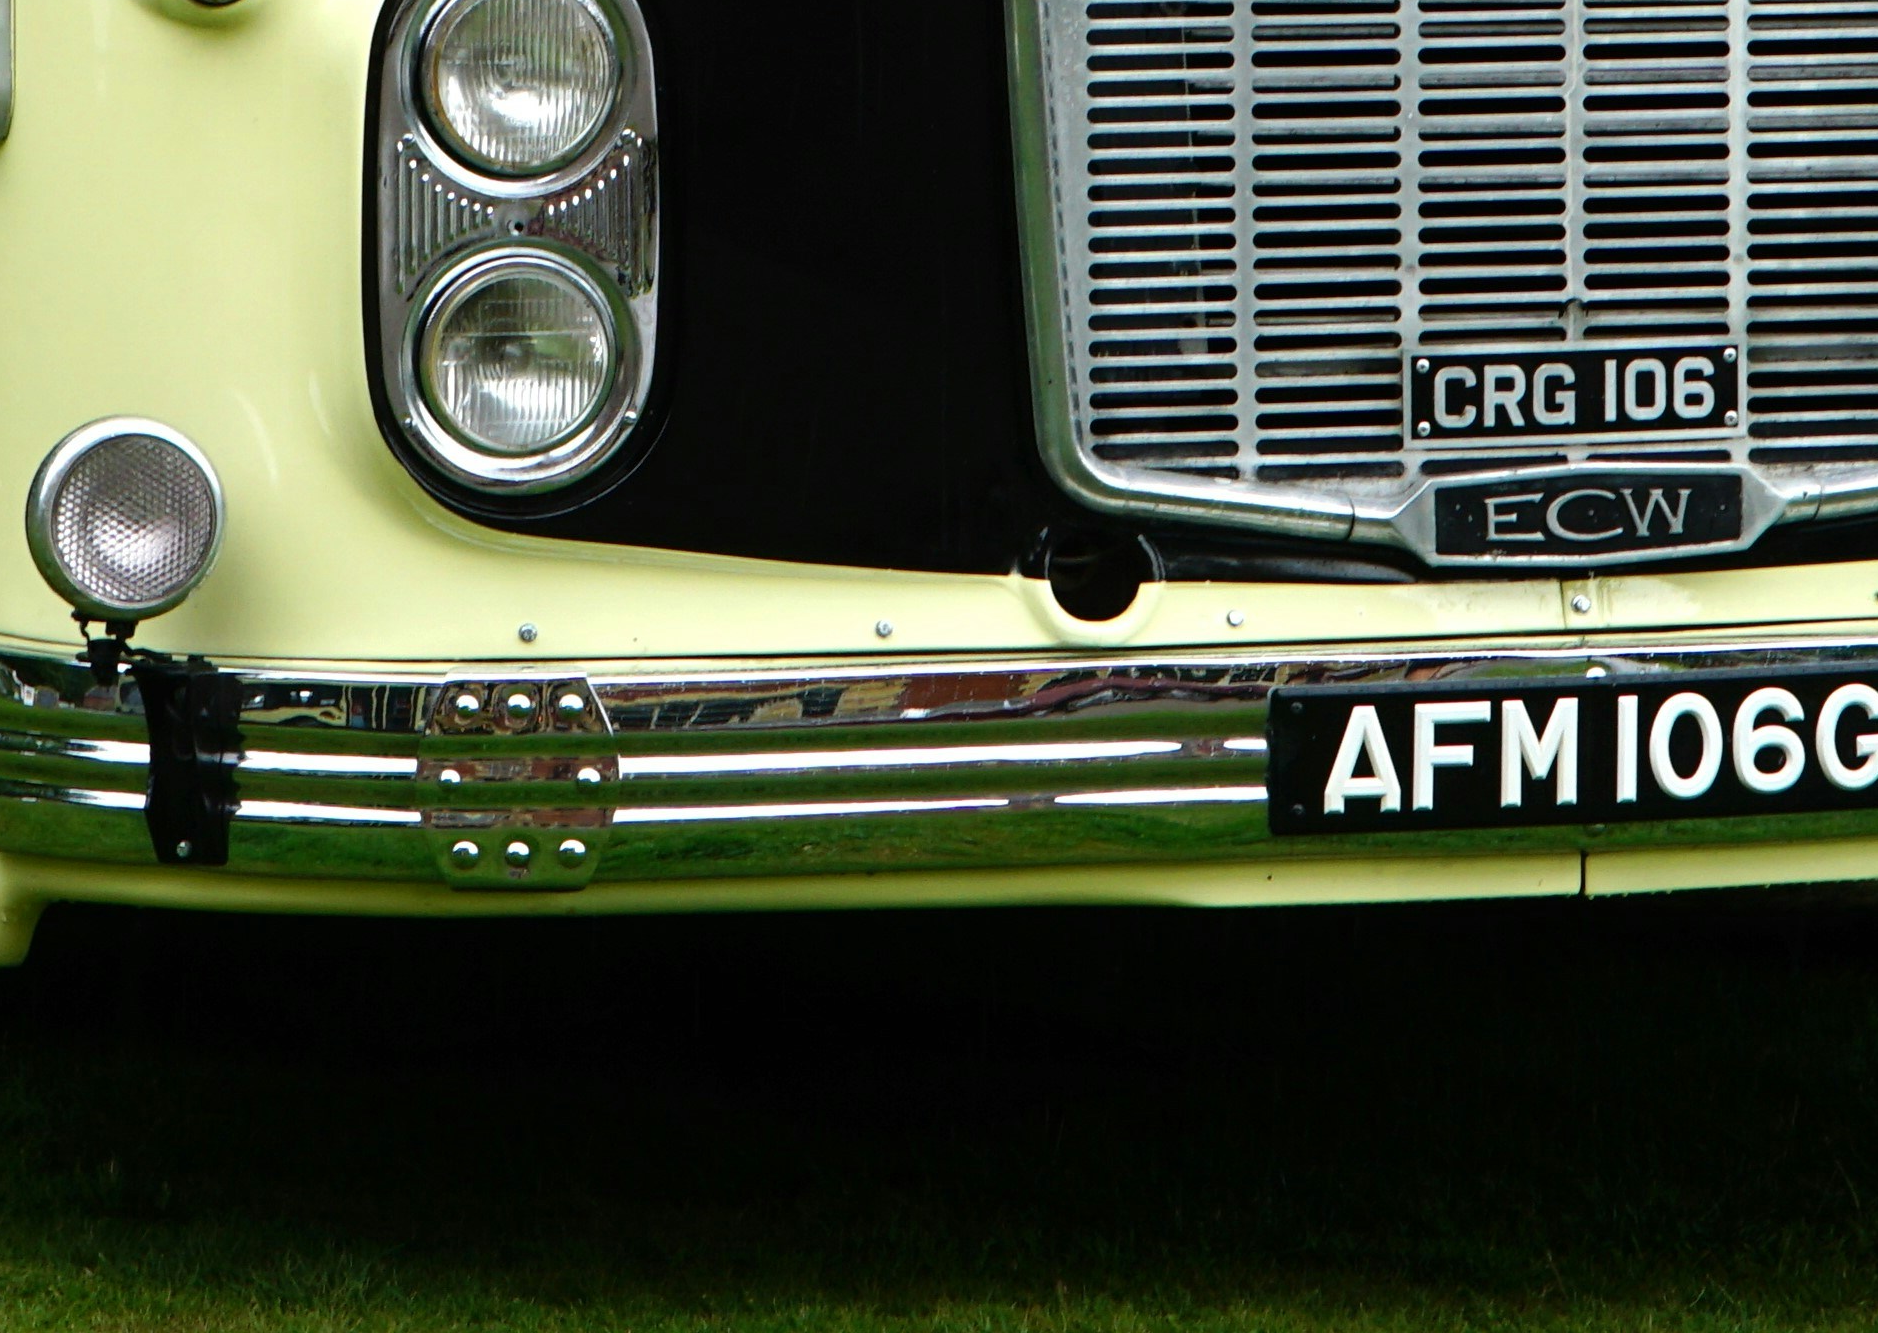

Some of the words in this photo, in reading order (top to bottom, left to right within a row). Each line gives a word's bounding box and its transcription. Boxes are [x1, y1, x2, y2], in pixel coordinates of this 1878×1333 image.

[1433, 361, 1576, 429] CRG
[1603, 356, 1717, 424] 106
[1484, 487, 1692, 543] ECW
[1323, 695, 1579, 815] AFM
